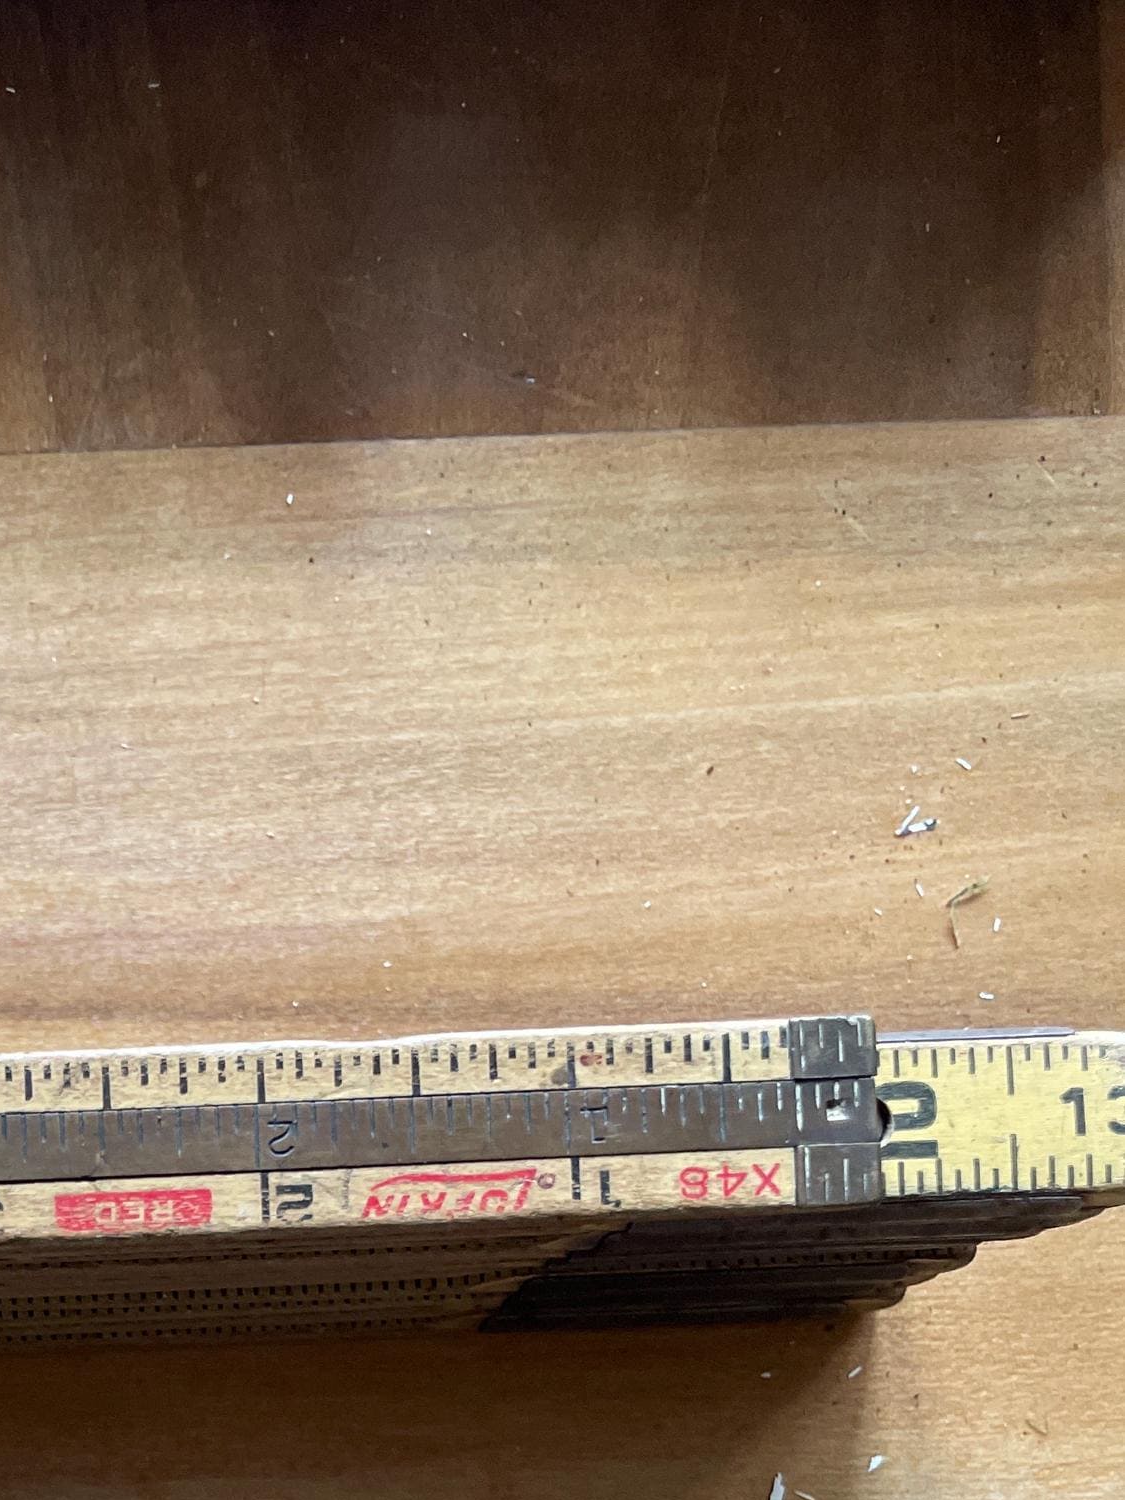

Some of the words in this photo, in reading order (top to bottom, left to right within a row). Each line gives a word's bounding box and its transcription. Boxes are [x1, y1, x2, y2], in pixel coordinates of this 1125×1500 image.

[267, 1120, 296, 1157] 2
[94, 1196, 178, 1223] RED
[275, 1183, 313, 1222] 2
[362, 1167, 536, 1219] LUFKIN
